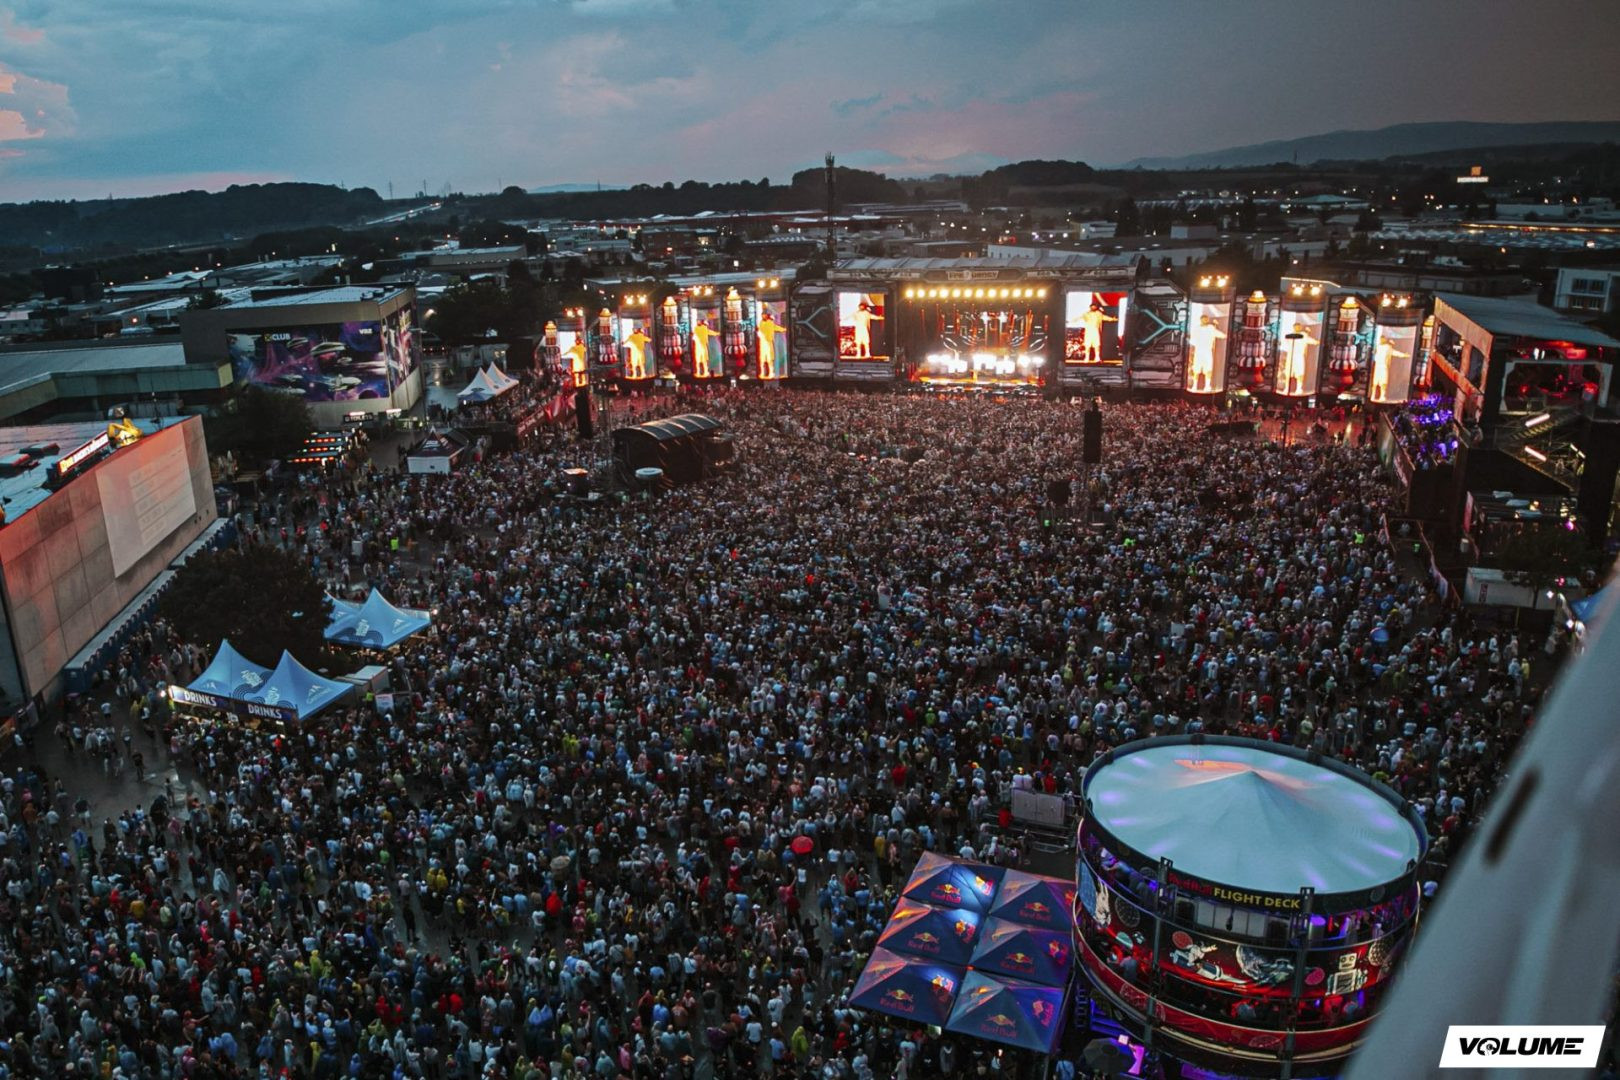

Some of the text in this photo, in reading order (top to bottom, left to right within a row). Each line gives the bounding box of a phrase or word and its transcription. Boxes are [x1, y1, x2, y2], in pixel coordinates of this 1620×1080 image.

[184, 690, 217, 707] DRINKS
[248, 704, 282, 719] DRINKS
[1214, 887, 1261, 905] FLIGHT
[1264, 897, 1301, 909] DECK
